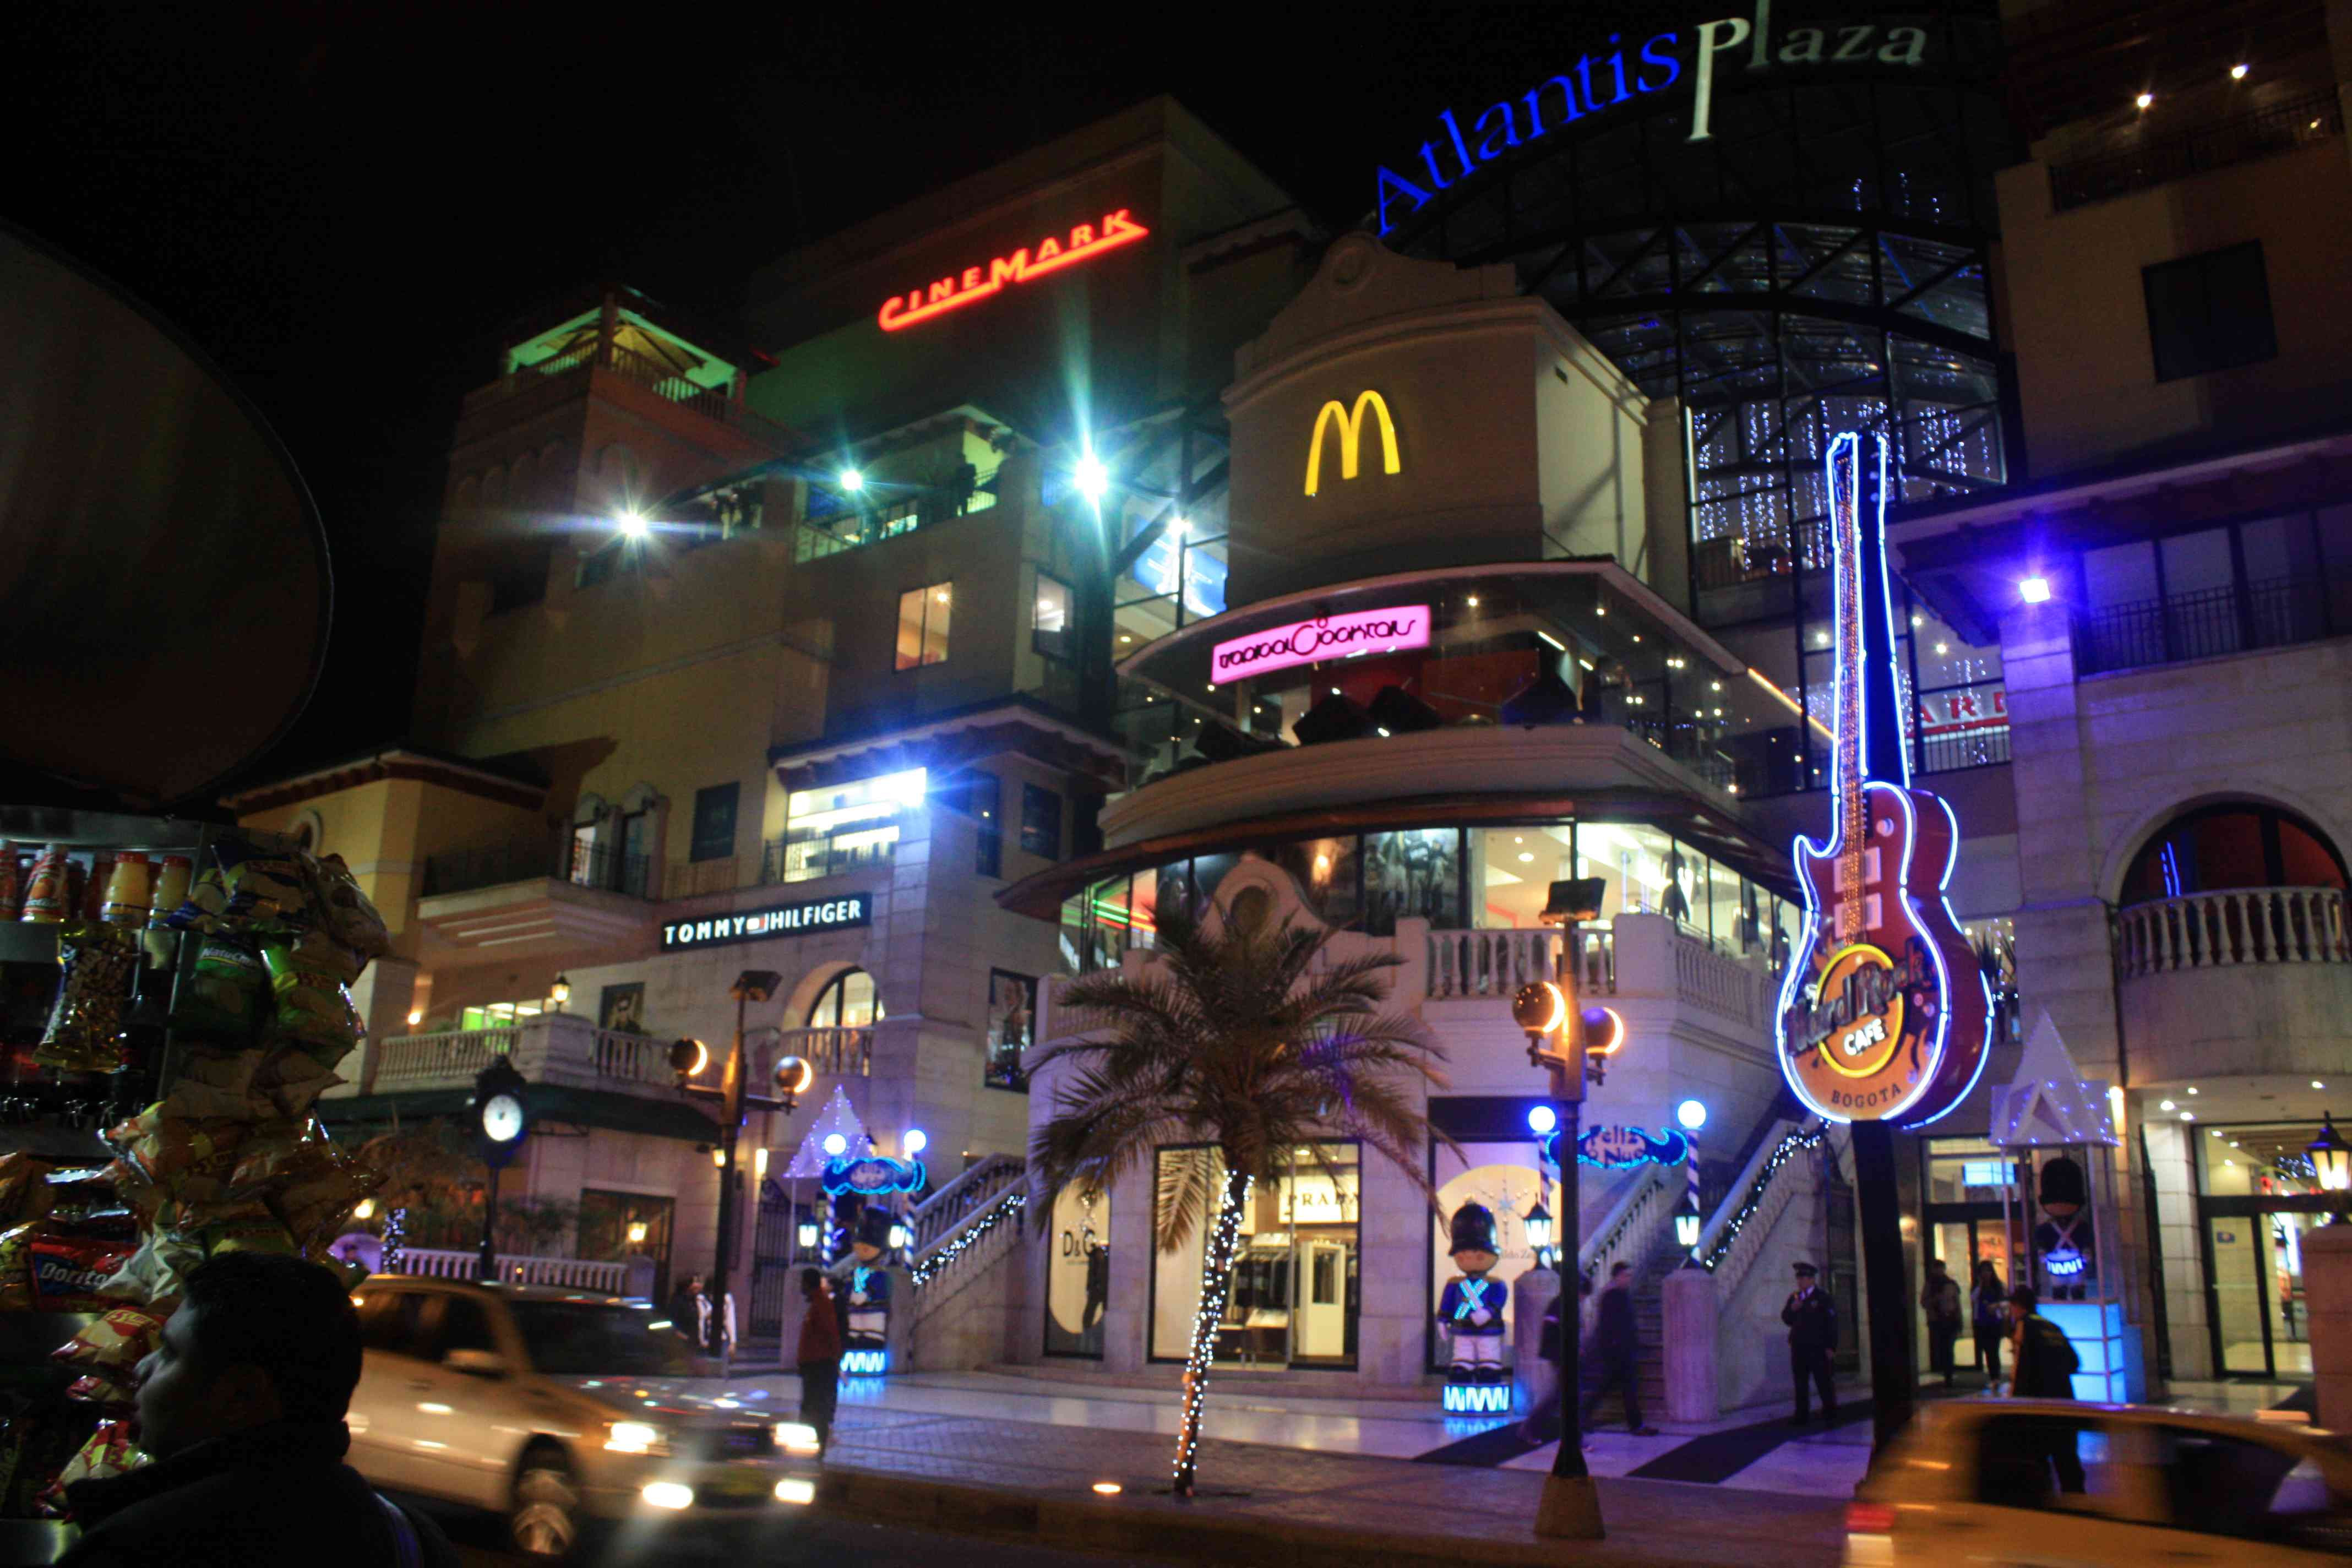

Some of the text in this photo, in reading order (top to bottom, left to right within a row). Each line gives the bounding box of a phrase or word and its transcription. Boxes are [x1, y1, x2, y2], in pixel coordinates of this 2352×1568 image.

[1375, 0, 1927, 238] Atlantis Plaza
[663, 899, 862, 945] TOMMY HILFIGER
[1784, 973, 1856, 1057] Hard
[1844, 1017, 1886, 1056] CAFE
[1831, 1082, 1902, 1109] BOGOTA
[40, 1261, 111, 1287] Dorito
